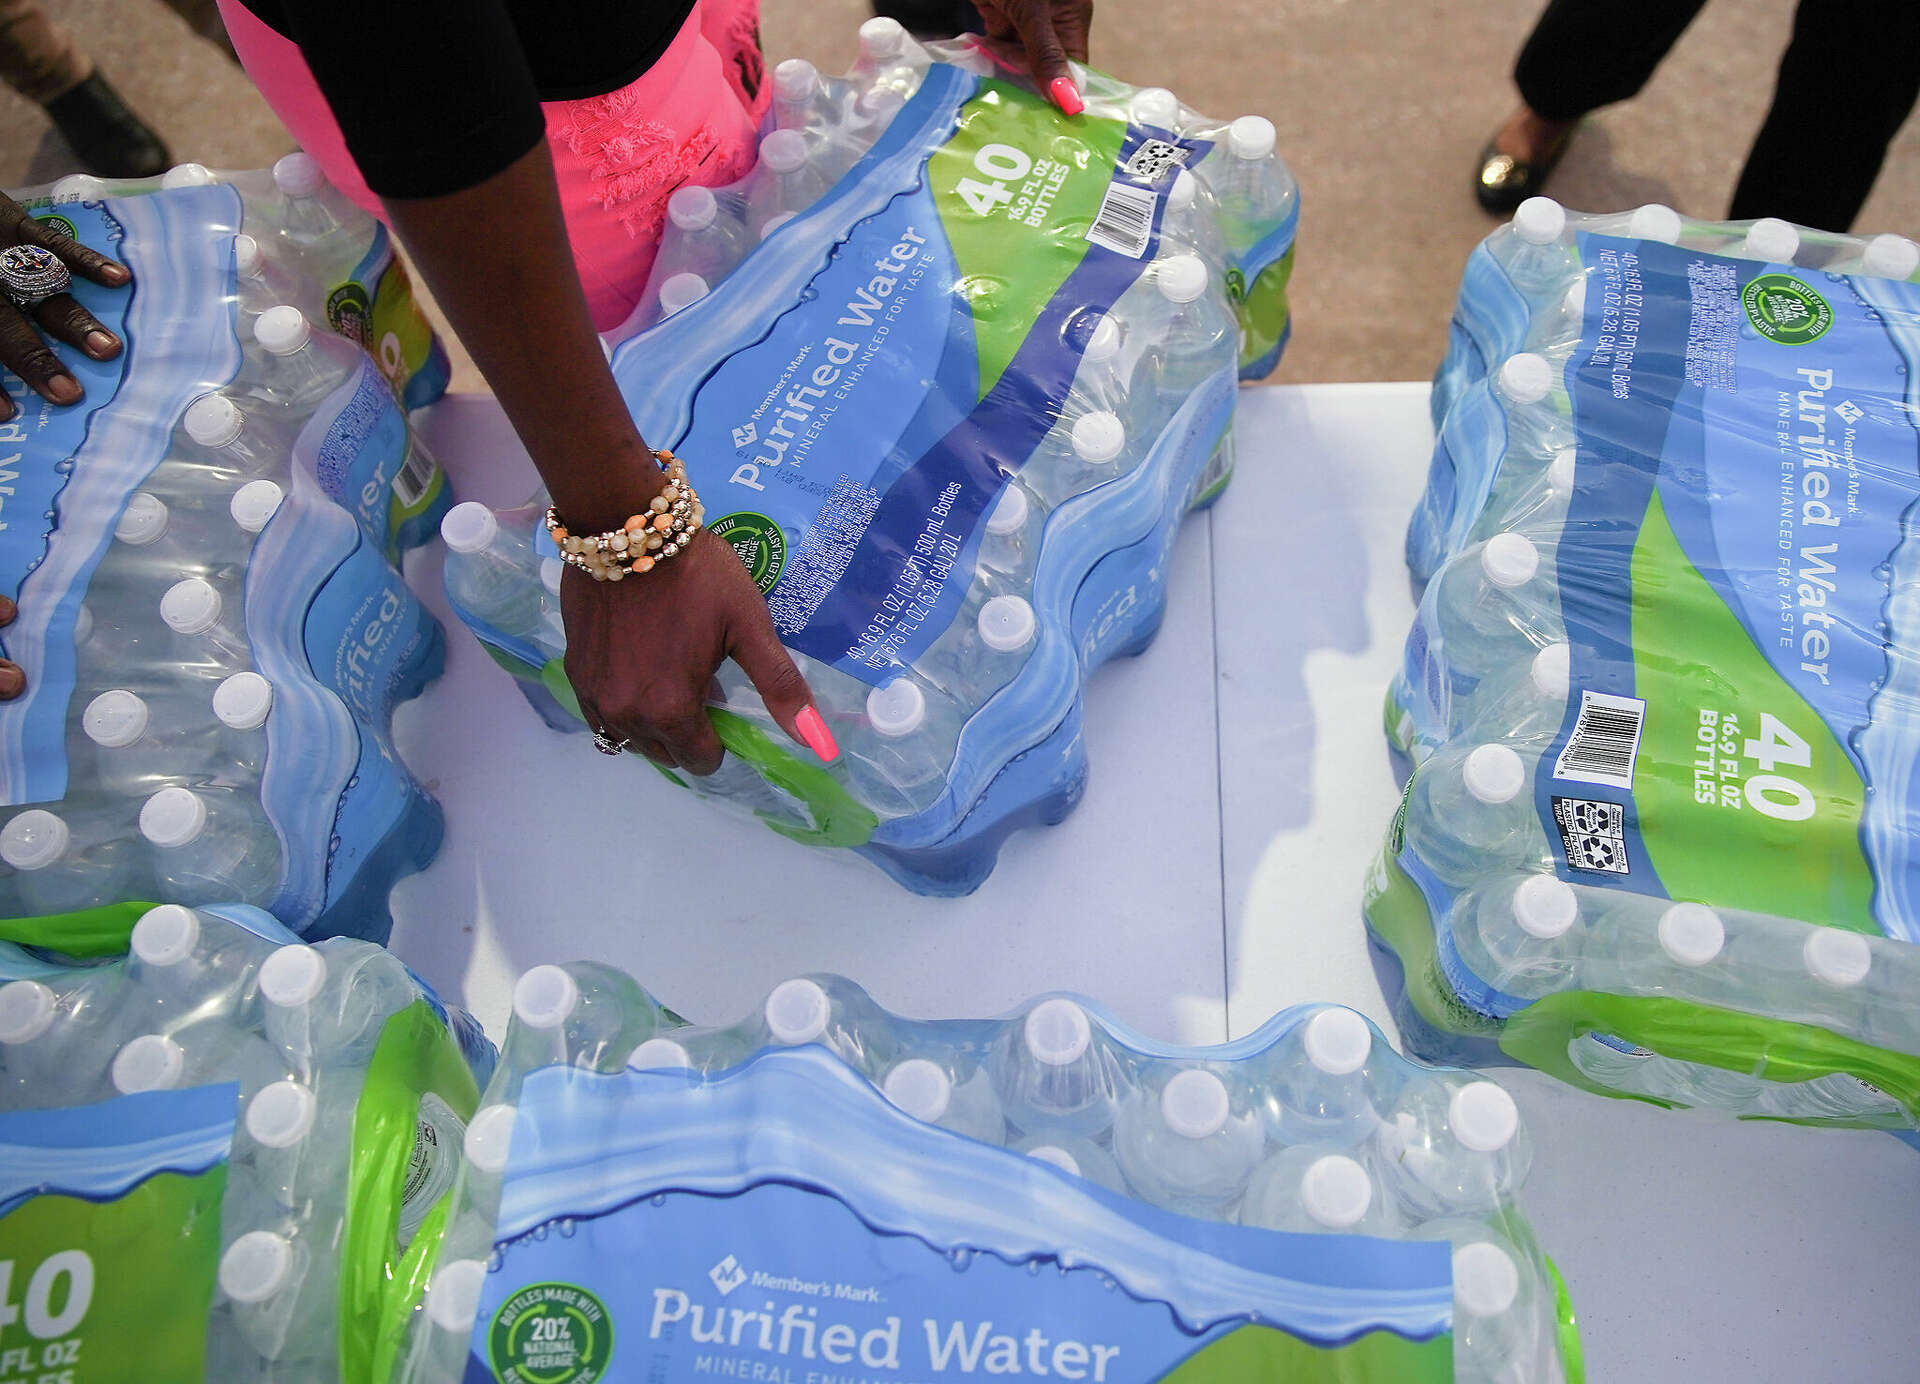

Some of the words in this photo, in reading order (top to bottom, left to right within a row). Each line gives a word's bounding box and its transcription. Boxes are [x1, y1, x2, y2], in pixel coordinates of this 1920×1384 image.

[955, 144, 1031, 216] 40
[1008, 196, 1032, 220] 16.9
[1020, 179, 1042, 196] FL
[1032, 159, 1052, 176] OZ
[1023, 161, 1070, 228] BOTTLES
[1600, 248, 1619, 268] NET
[1604, 282, 1622, 290] FL
[1604, 292, 1621, 306] OZ
[1625, 282, 1643, 292] FL
[1745, 284, 1762, 308] RECYCLED
[1789, 281, 1821, 304] BOTTLES
[1624, 294, 1643, 307] OZ
[1785, 298, 1809, 318] 20%
[1816, 304, 1828, 321] MADE
[1601, 306, 1619, 332] (5.28
[1621, 307, 1641, 332] (1.05
[1749, 309, 1775, 335] PLASTIC
[1808, 321, 1824, 335] WITH
[1594, 335, 1615, 354] GAL)
[1615, 334, 1637, 349] PT)
[728, 337, 860, 492] Purified
[837, 226, 928, 326] Water
[790, 405, 838, 468] MINERAL
[834, 326, 889, 400] ENHANCED
[885, 296, 908, 322] FOR
[902, 252, 936, 291] TASTE
[750, 372, 792, 420] Member's
[786, 346, 812, 372] Mark
[1776, 391, 1794, 455] MINERAL
[1796, 368, 1841, 526] Purified
[931, 482, 962, 518] Bottles
[1779, 462, 1794, 550] ENHANCED
[1847, 480, 1860, 513] Mark
[711, 518, 736, 533] WITH
[926, 518, 944, 536] mL
[944, 533, 962, 542] L
[765, 527, 781, 558] PLASTIC
[914, 533, 936, 556] 500
[939, 540, 958, 558] 20
[774, 585, 784, 595] ON
[784, 548, 805, 578] JOURNEY
[782, 562, 806, 596] ALTHOUGH
[802, 547, 816, 562] THIS
[929, 554, 955, 580] GAL)
[1777, 557, 1791, 586] FOR
[893, 568, 920, 598] (1.05
[915, 579, 944, 608] (5.28
[782, 597, 803, 622] YEARLY
[801, 586, 820, 608] BASED
[882, 593, 906, 612] OZ
[773, 596, 795, 626] ECYCLED
[873, 612, 896, 628] FL
[905, 602, 928, 622] OZ
[1779, 594, 1792, 648] TASTE
[1796, 543, 1838, 685] Water
[895, 620, 917, 636] FL
[846, 624, 884, 660] 40-16.9
[880, 633, 906, 658] 676
[864, 649, 892, 670] NET
[1718, 713, 1741, 754] 16.9
[1694, 709, 1718, 805] BOTTLES
[1719, 759, 1738, 781] FL
[1744, 712, 1816, 821] 40
[1721, 785, 1741, 809] OZ
[1554, 803, 1563, 824] WRAP
[1564, 800, 1573, 830] PLASTIC
[1570, 835, 1582, 865] PLASTIC
[752, 1271, 830, 1297] Member's
[834, 1284, 878, 1303] Mark
[499, 1289, 542, 1326] BOTTLES
[531, 1316, 571, 1340] 20%
[649, 1288, 900, 1369] Purified
[925, 1317, 1120, 1381] Water
[42, 1339, 82, 1368] OZ
[695, 1355, 792, 1384] MINERAL
